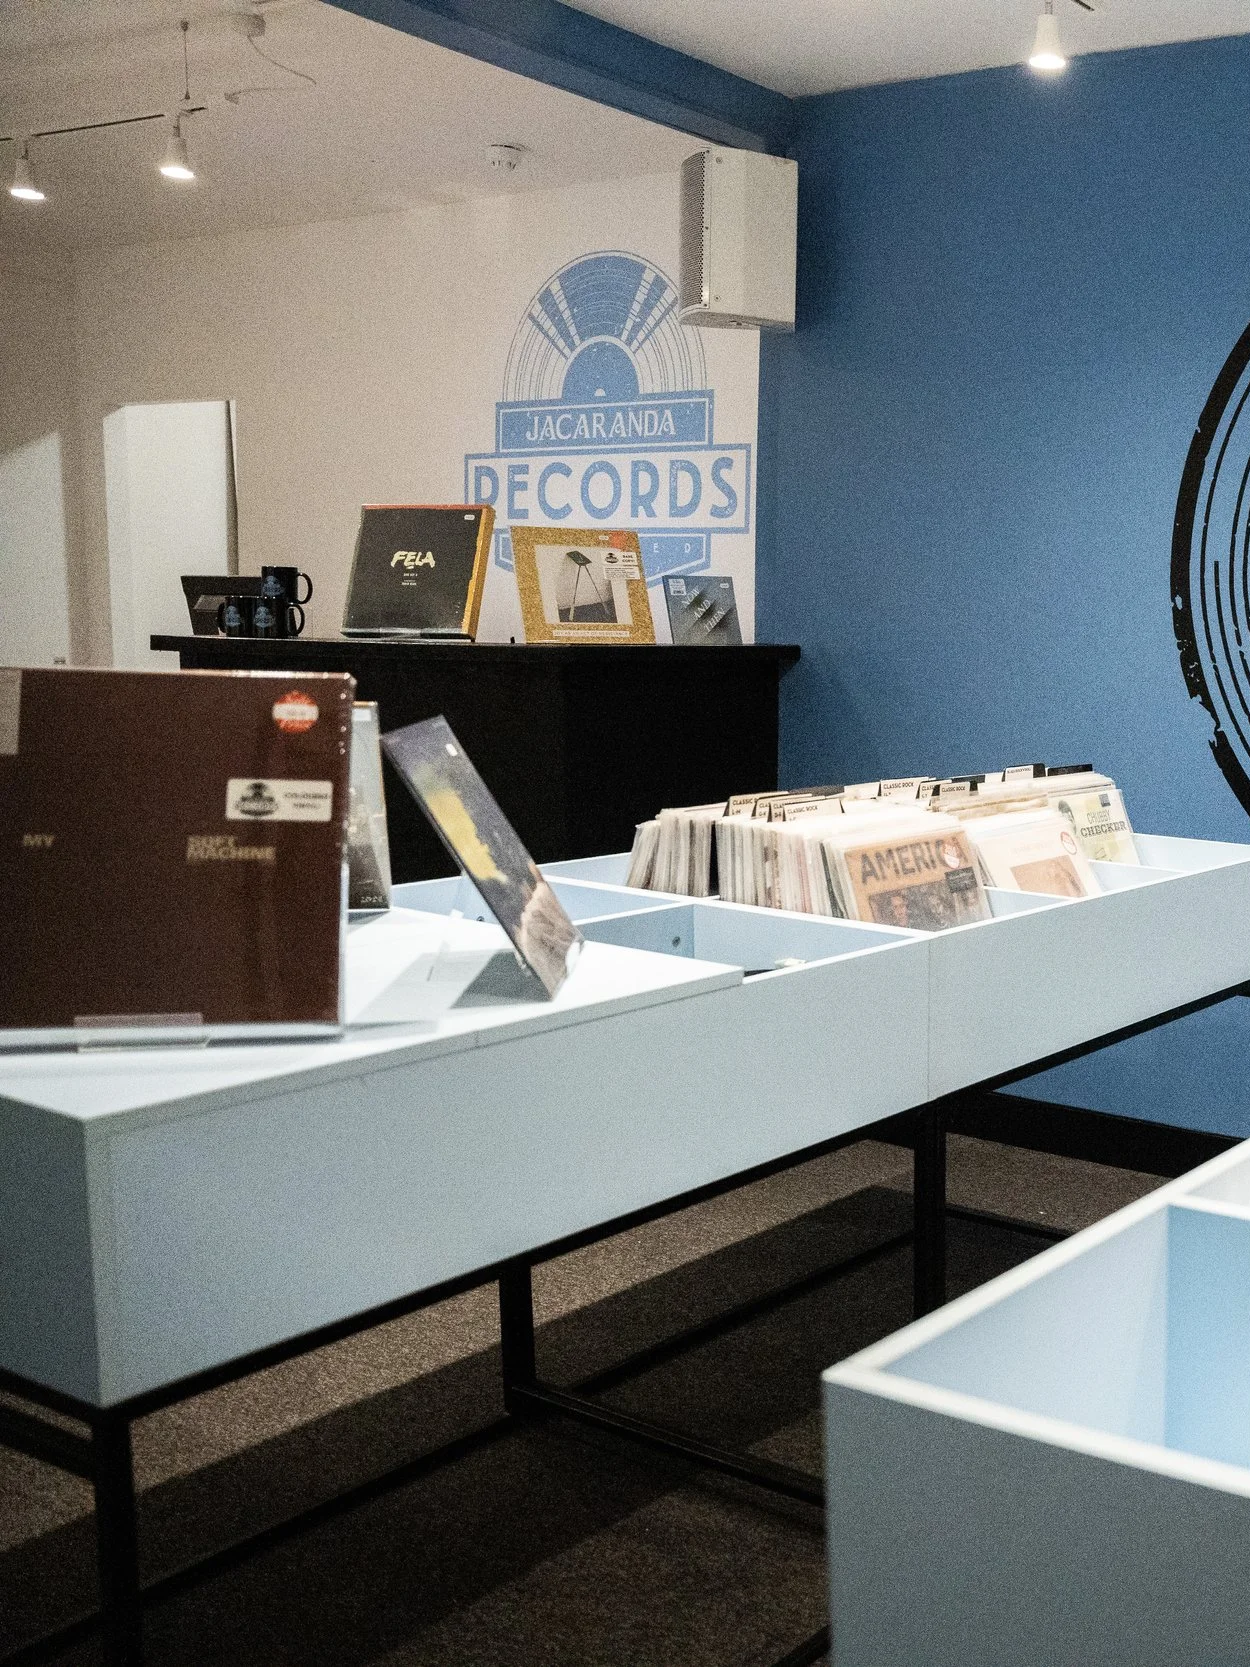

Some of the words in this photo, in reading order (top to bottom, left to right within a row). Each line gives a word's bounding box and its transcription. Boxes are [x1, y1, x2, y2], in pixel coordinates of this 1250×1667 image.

[525, 410, 676, 441] JACARANDA
[1086, 809, 1111, 825] CHUBBY
[1080, 820, 1128, 838] CHECKER
